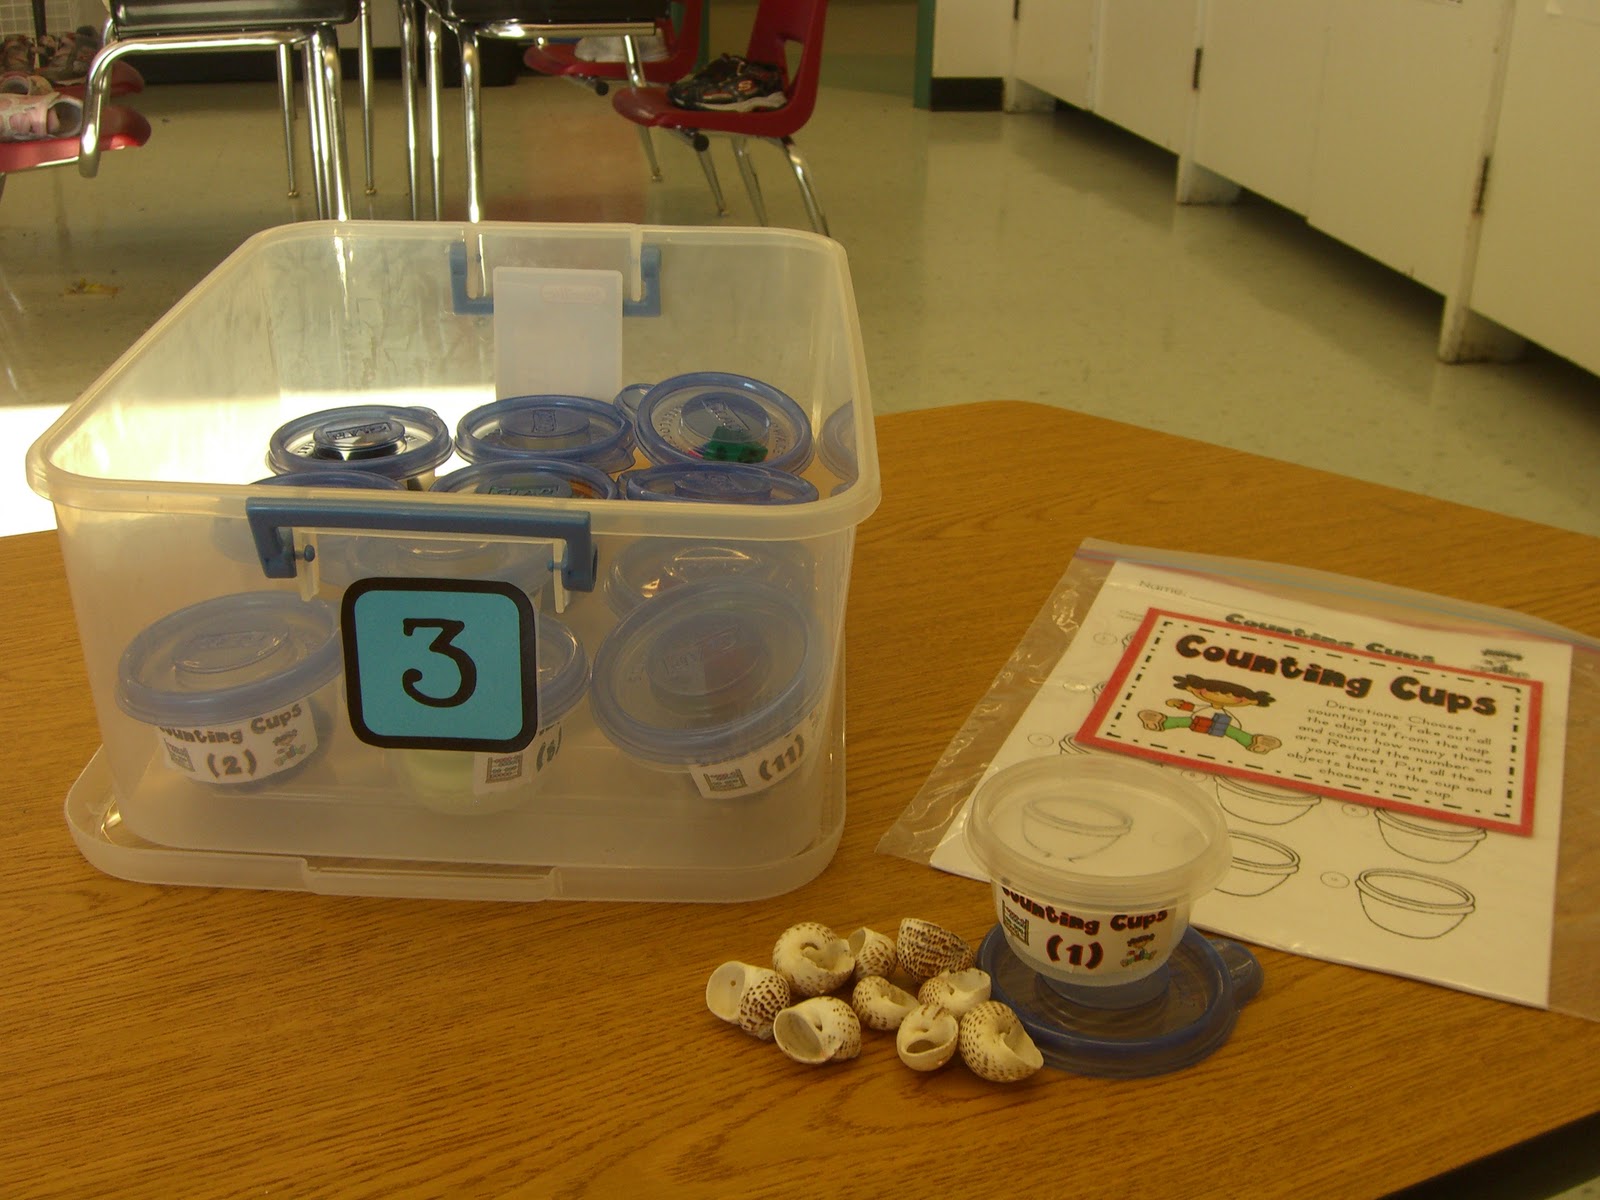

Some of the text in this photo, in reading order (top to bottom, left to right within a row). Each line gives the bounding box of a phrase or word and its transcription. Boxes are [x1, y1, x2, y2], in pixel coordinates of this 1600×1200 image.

[402, 618, 477, 708] 3
[1176, 634, 1497, 716] Counting Cups
[250, 703, 303, 735] Cups
[1306, 715, 1490, 757] the objects from the cup
[1308, 707, 1367, 726] counting
[1406, 723, 1441, 737] Take
[1446, 732, 1470, 743] out
[1476, 737, 1492, 746] all
[1408, 715, 1463, 732] Choose
[207, 748, 258, 779] (2)
[758, 734, 805, 781] (11)
[1298, 724, 1493, 765] and count how many there
[1327, 738, 1381, 755] Record
[1386, 750, 1410, 760] the
[1415, 756, 1469, 771] number
[1475, 767, 1492, 776] on
[1287, 750, 1493, 796] objects back in the cup and
[1305, 746, 1338, 756] your
[1394, 760, 1423, 773] Put
[1430, 769, 1446, 777] all
[1451, 772, 1476, 782] the
[1319, 768, 1370, 783] choose
[1389, 783, 1420, 793] new
[1110, 908, 1168, 932] Cups
[1046, 933, 1105, 970] (1)
